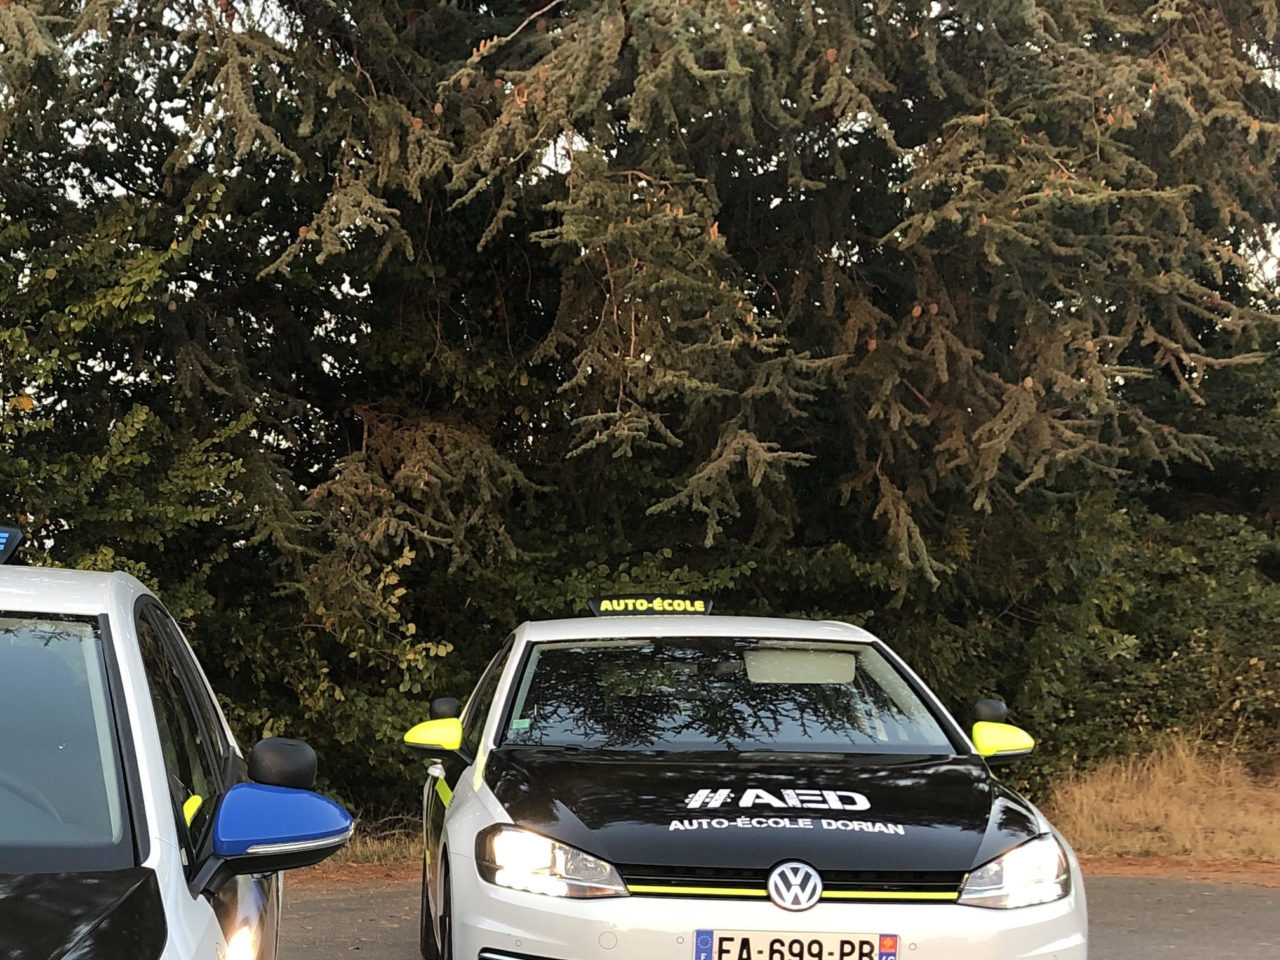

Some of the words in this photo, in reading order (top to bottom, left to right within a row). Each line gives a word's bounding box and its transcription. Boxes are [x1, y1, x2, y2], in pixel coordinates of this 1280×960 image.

[600, 597, 705, 612] AUTO-ÉCOLE
[669, 816, 814, 831] AUTO-ÉCOLE
[821, 818, 905, 835] DORIAN
